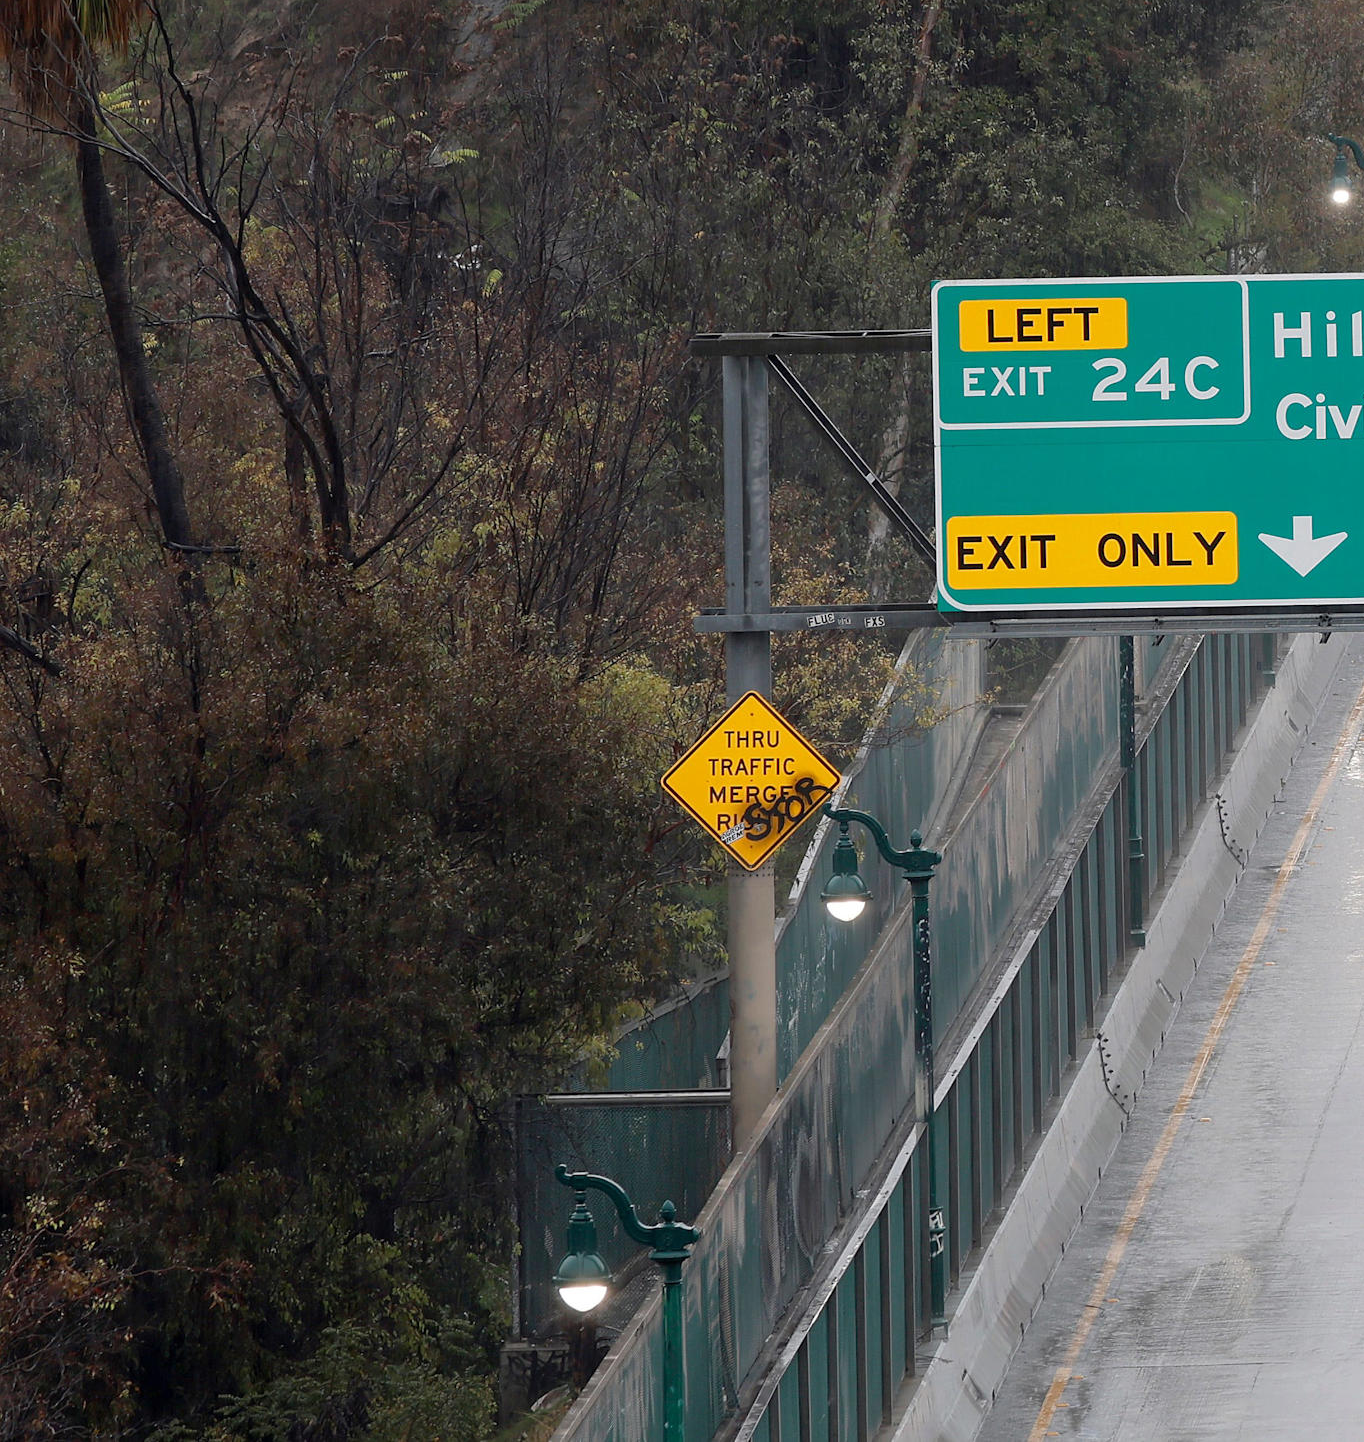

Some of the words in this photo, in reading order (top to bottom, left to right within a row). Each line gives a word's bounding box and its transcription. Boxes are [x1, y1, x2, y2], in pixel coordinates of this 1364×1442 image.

[987, 307, 1099, 343] LEFT
[962, 365, 1052, 397] EXIT
[1091, 355, 1220, 402] 24C
[957, 534, 1056, 570] EXIT
[1097, 531, 1226, 568] ONLY
[724, 730, 780, 749] THRU
[708, 757, 796, 776] TRAFFIC
